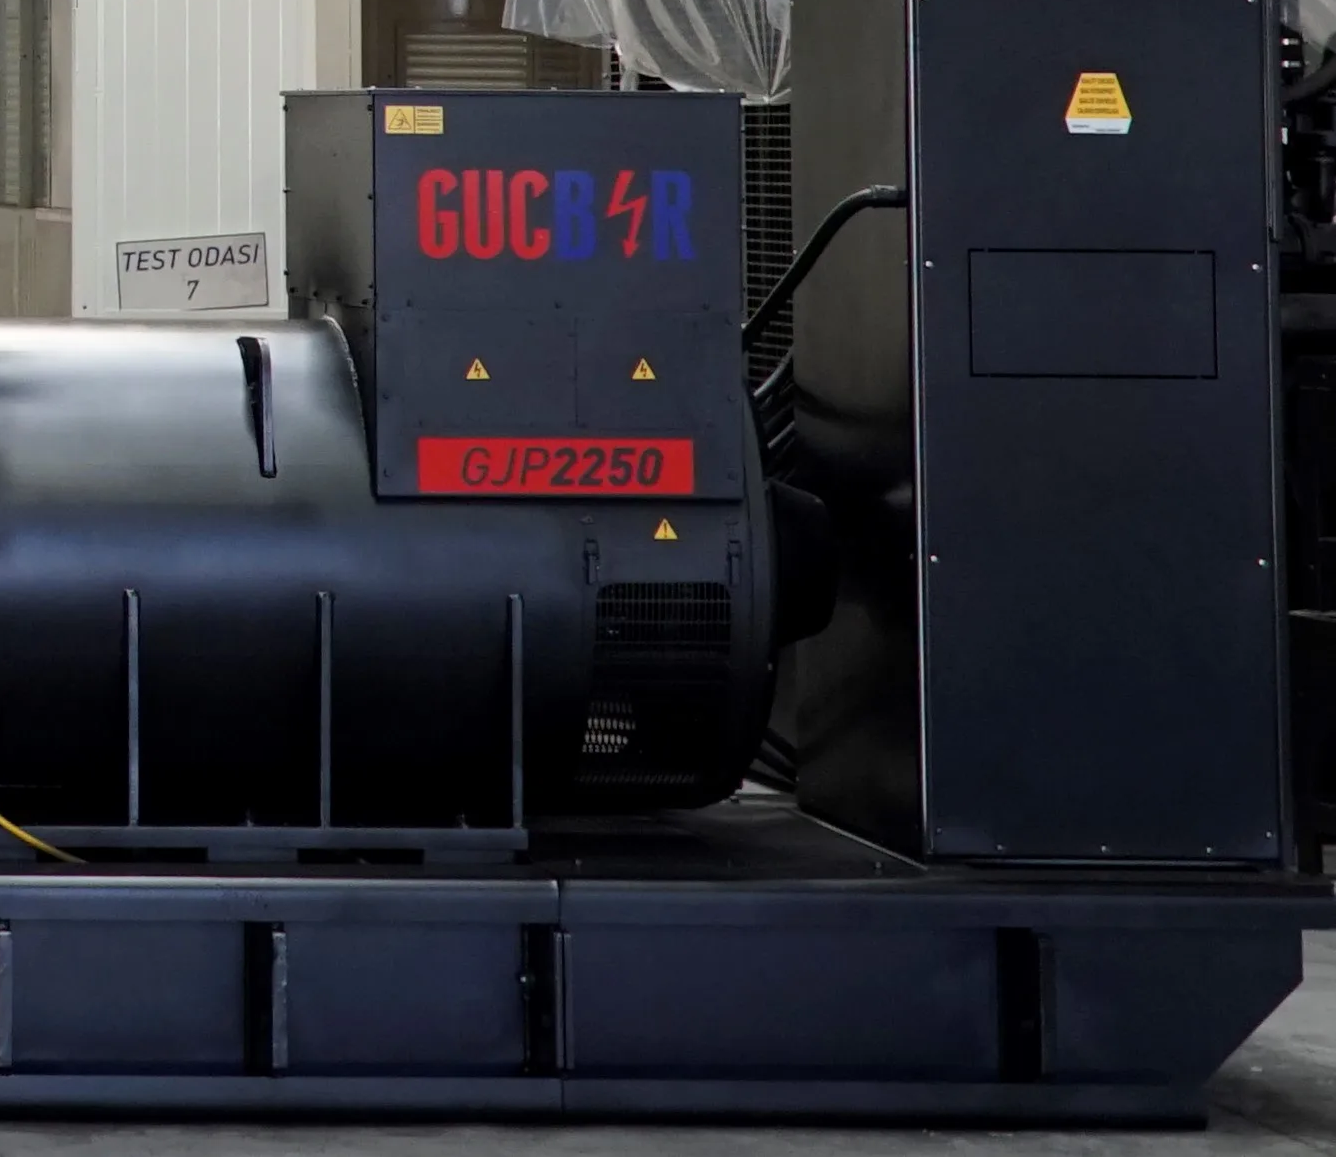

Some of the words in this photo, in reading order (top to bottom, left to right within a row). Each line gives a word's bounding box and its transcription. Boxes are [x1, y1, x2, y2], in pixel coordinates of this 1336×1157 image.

[123, 248, 181, 272] TEST
[187, 243, 259, 268] ODASI
[187, 279, 200, 301] 7
[460, 446, 665, 487] GJP2250
